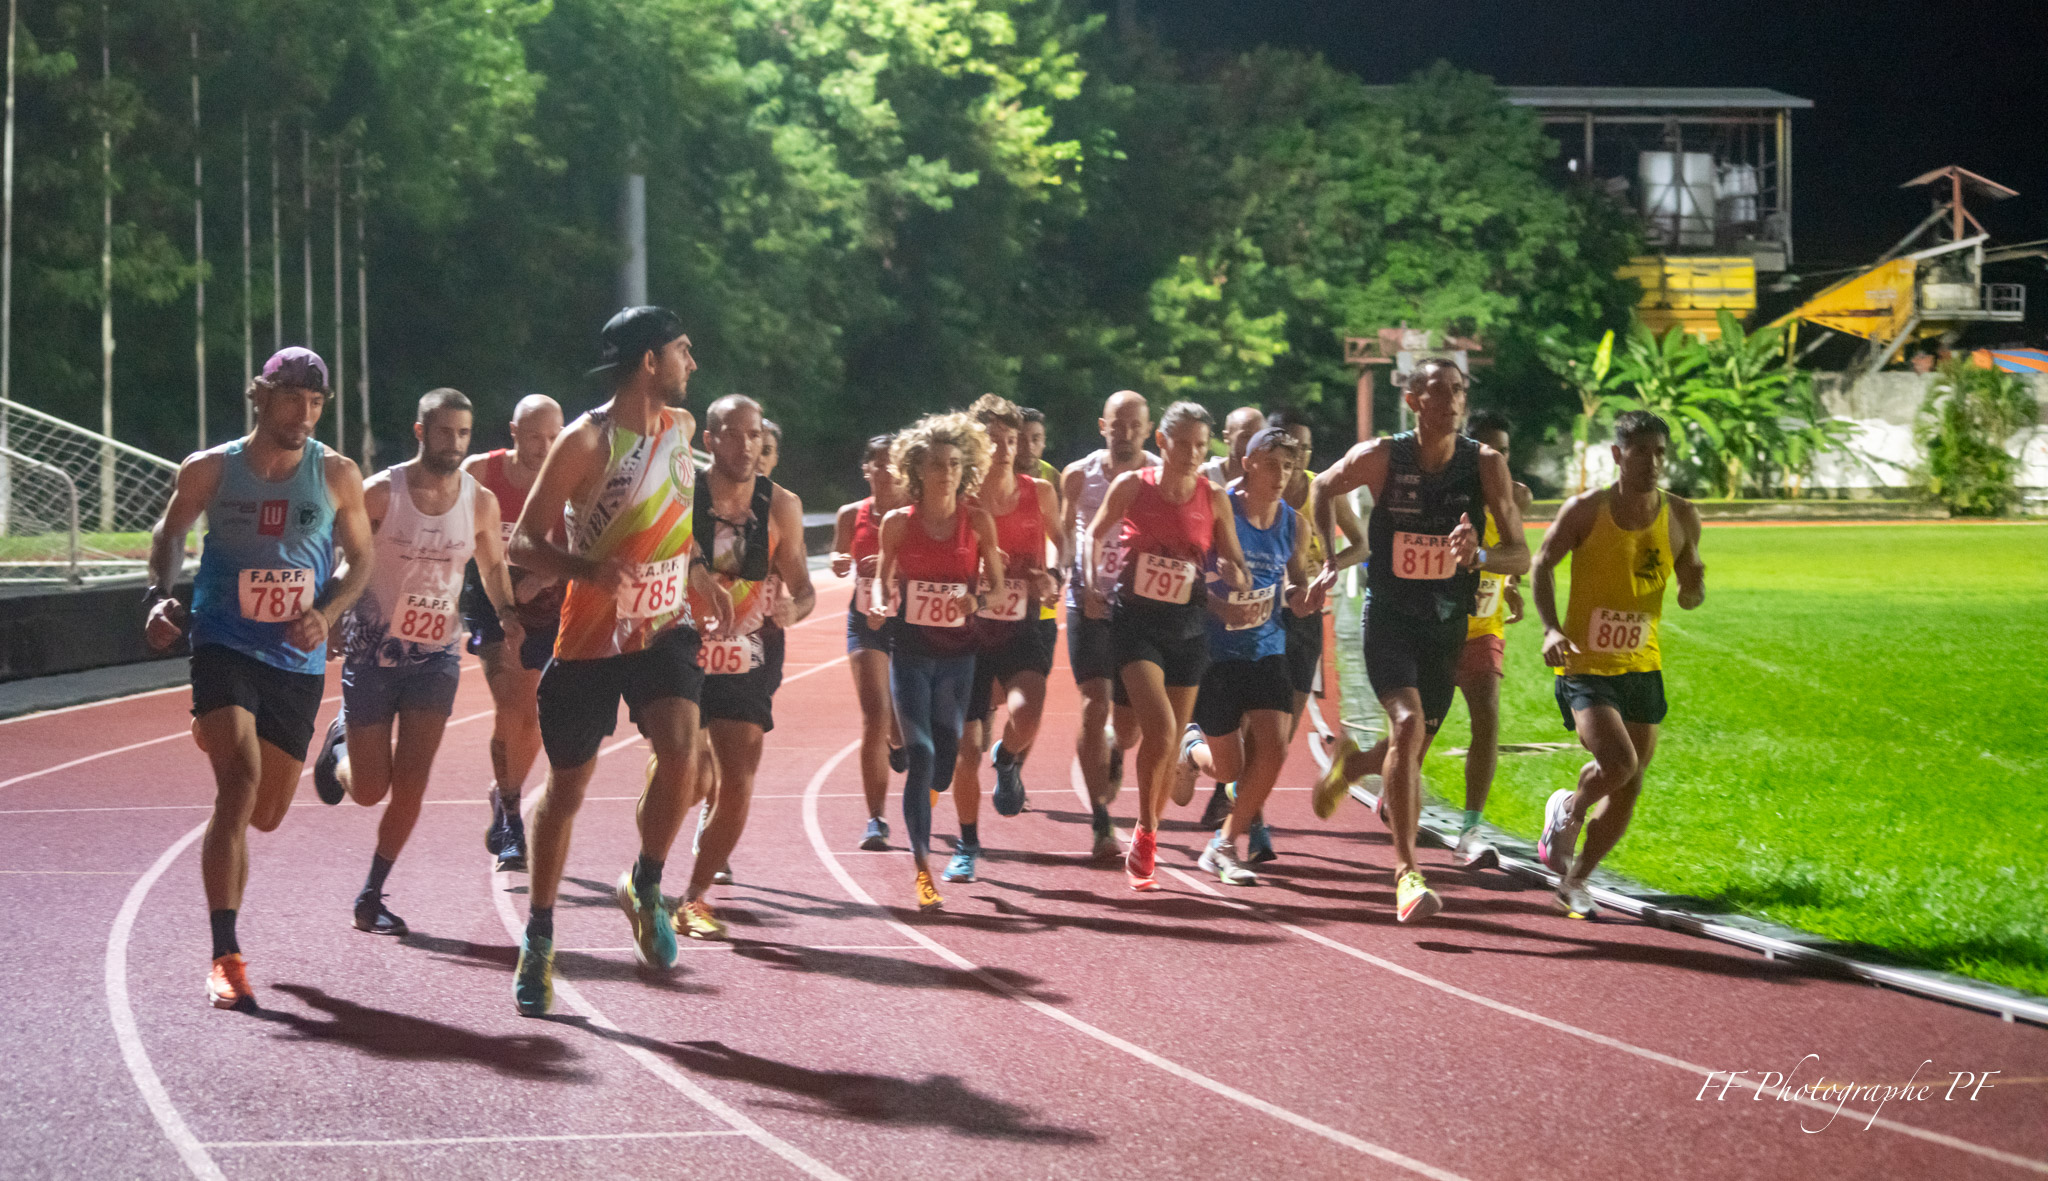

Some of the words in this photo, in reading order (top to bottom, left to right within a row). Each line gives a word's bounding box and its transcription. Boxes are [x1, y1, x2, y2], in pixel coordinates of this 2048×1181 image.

[264, 506, 282, 525] LU
[1402, 548, 1445, 575] 811
[250, 571, 305, 583] F.A.P.F.
[1144, 568, 1186, 599] 797
[250, 586, 304, 617] 787
[407, 595, 450, 611] F.A.P.F.
[631, 575, 677, 613] 785
[916, 595, 958, 623] 786
[401, 609, 447, 641] 828
[1597, 624, 1642, 649] 808
[697, 645, 741, 673] 805
